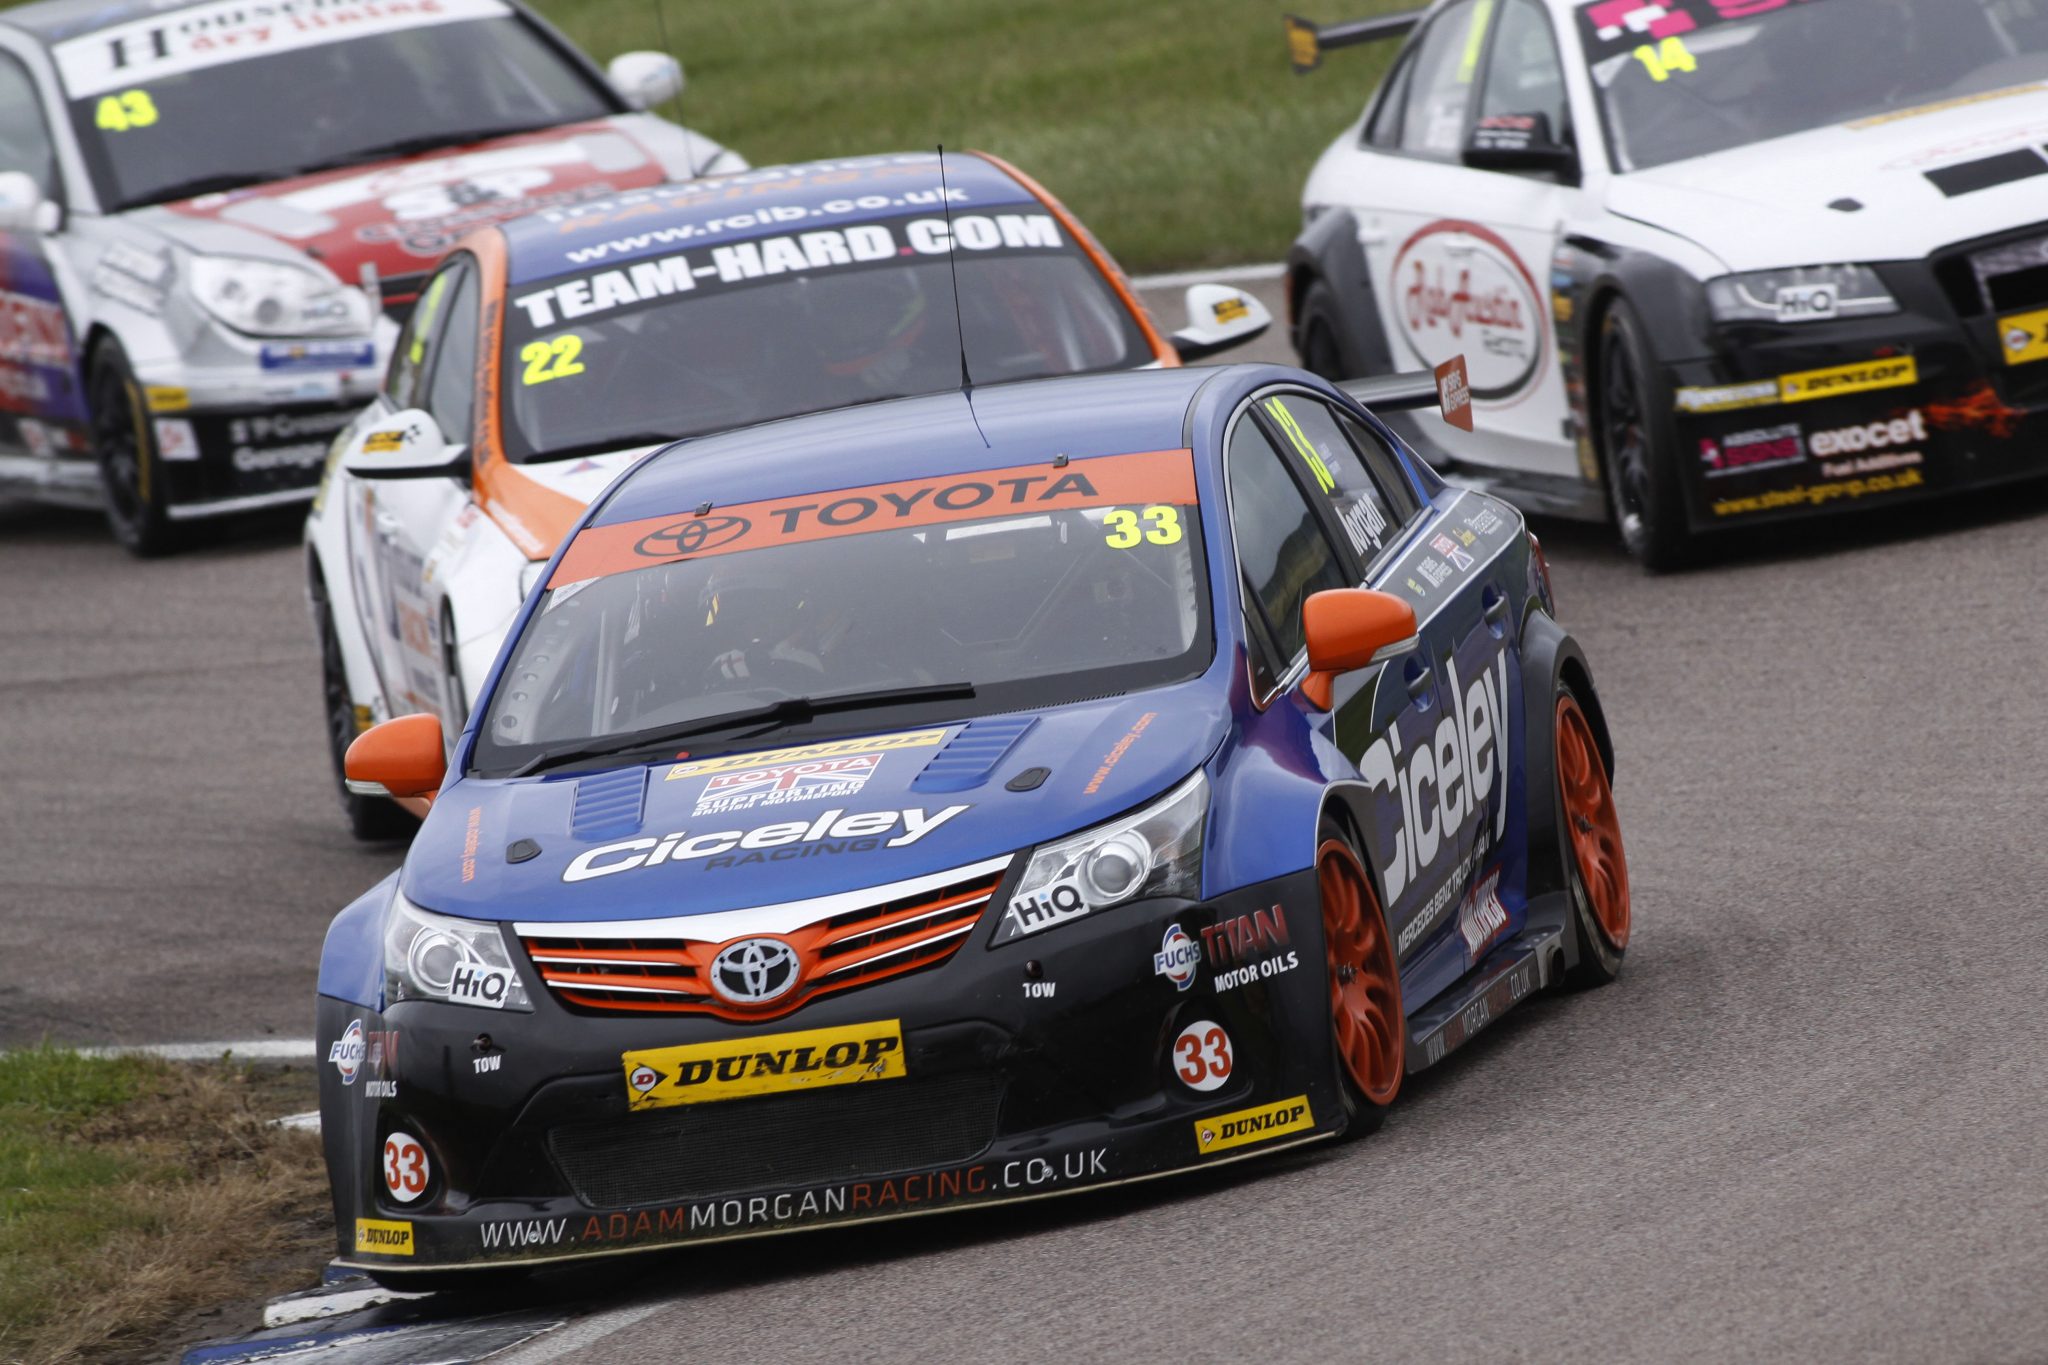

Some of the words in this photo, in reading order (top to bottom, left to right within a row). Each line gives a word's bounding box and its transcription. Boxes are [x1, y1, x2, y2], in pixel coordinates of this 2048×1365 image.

[1634, 36, 1697, 81] 14
[96, 88, 158, 132] 43
[565, 186, 969, 264] www.rcib.co.uk
[514, 215, 1063, 327] TEAM-HARD.COM
[1782, 288, 1832, 315] HiQ
[520, 334, 585, 386] 22
[1805, 364, 1909, 390] DUNLOP
[1809, 409, 1928, 457] exocet
[770, 471, 1099, 533] TOYOTA
[1104, 505, 1182, 550] 33
[706, 734, 941, 768] DUNLOP
[715, 757, 874, 786] TOYOTA
[695, 780, 865, 811] SUPPORTING
[1359, 648, 1508, 908] Ciceley
[691, 801, 755, 817] BRITISH
[760, 788, 860, 807] MOTORSPORT
[562, 804, 970, 882] Ciceley
[705, 838, 881, 872] RACING
[1014, 885, 1084, 926] HiQ
[1398, 898, 1434, 957] MERCEDES
[1434, 878, 1452, 917] BENZ
[1155, 942, 1200, 973] FUCHS
[1214, 963, 1259, 994] MOTOR
[1262, 951, 1299, 979] OILS
[451, 966, 506, 1002] HiQ
[1022, 982, 1056, 998] TOW
[473, 1055, 501, 1074] TOW
[674, 1036, 900, 1087] DUNLOP
[1174, 1027, 1232, 1085] 33
[1220, 1105, 1305, 1140] DUNLOP
[384, 1141, 428, 1193] 33
[366, 1228, 410, 1245] DUNLOP
